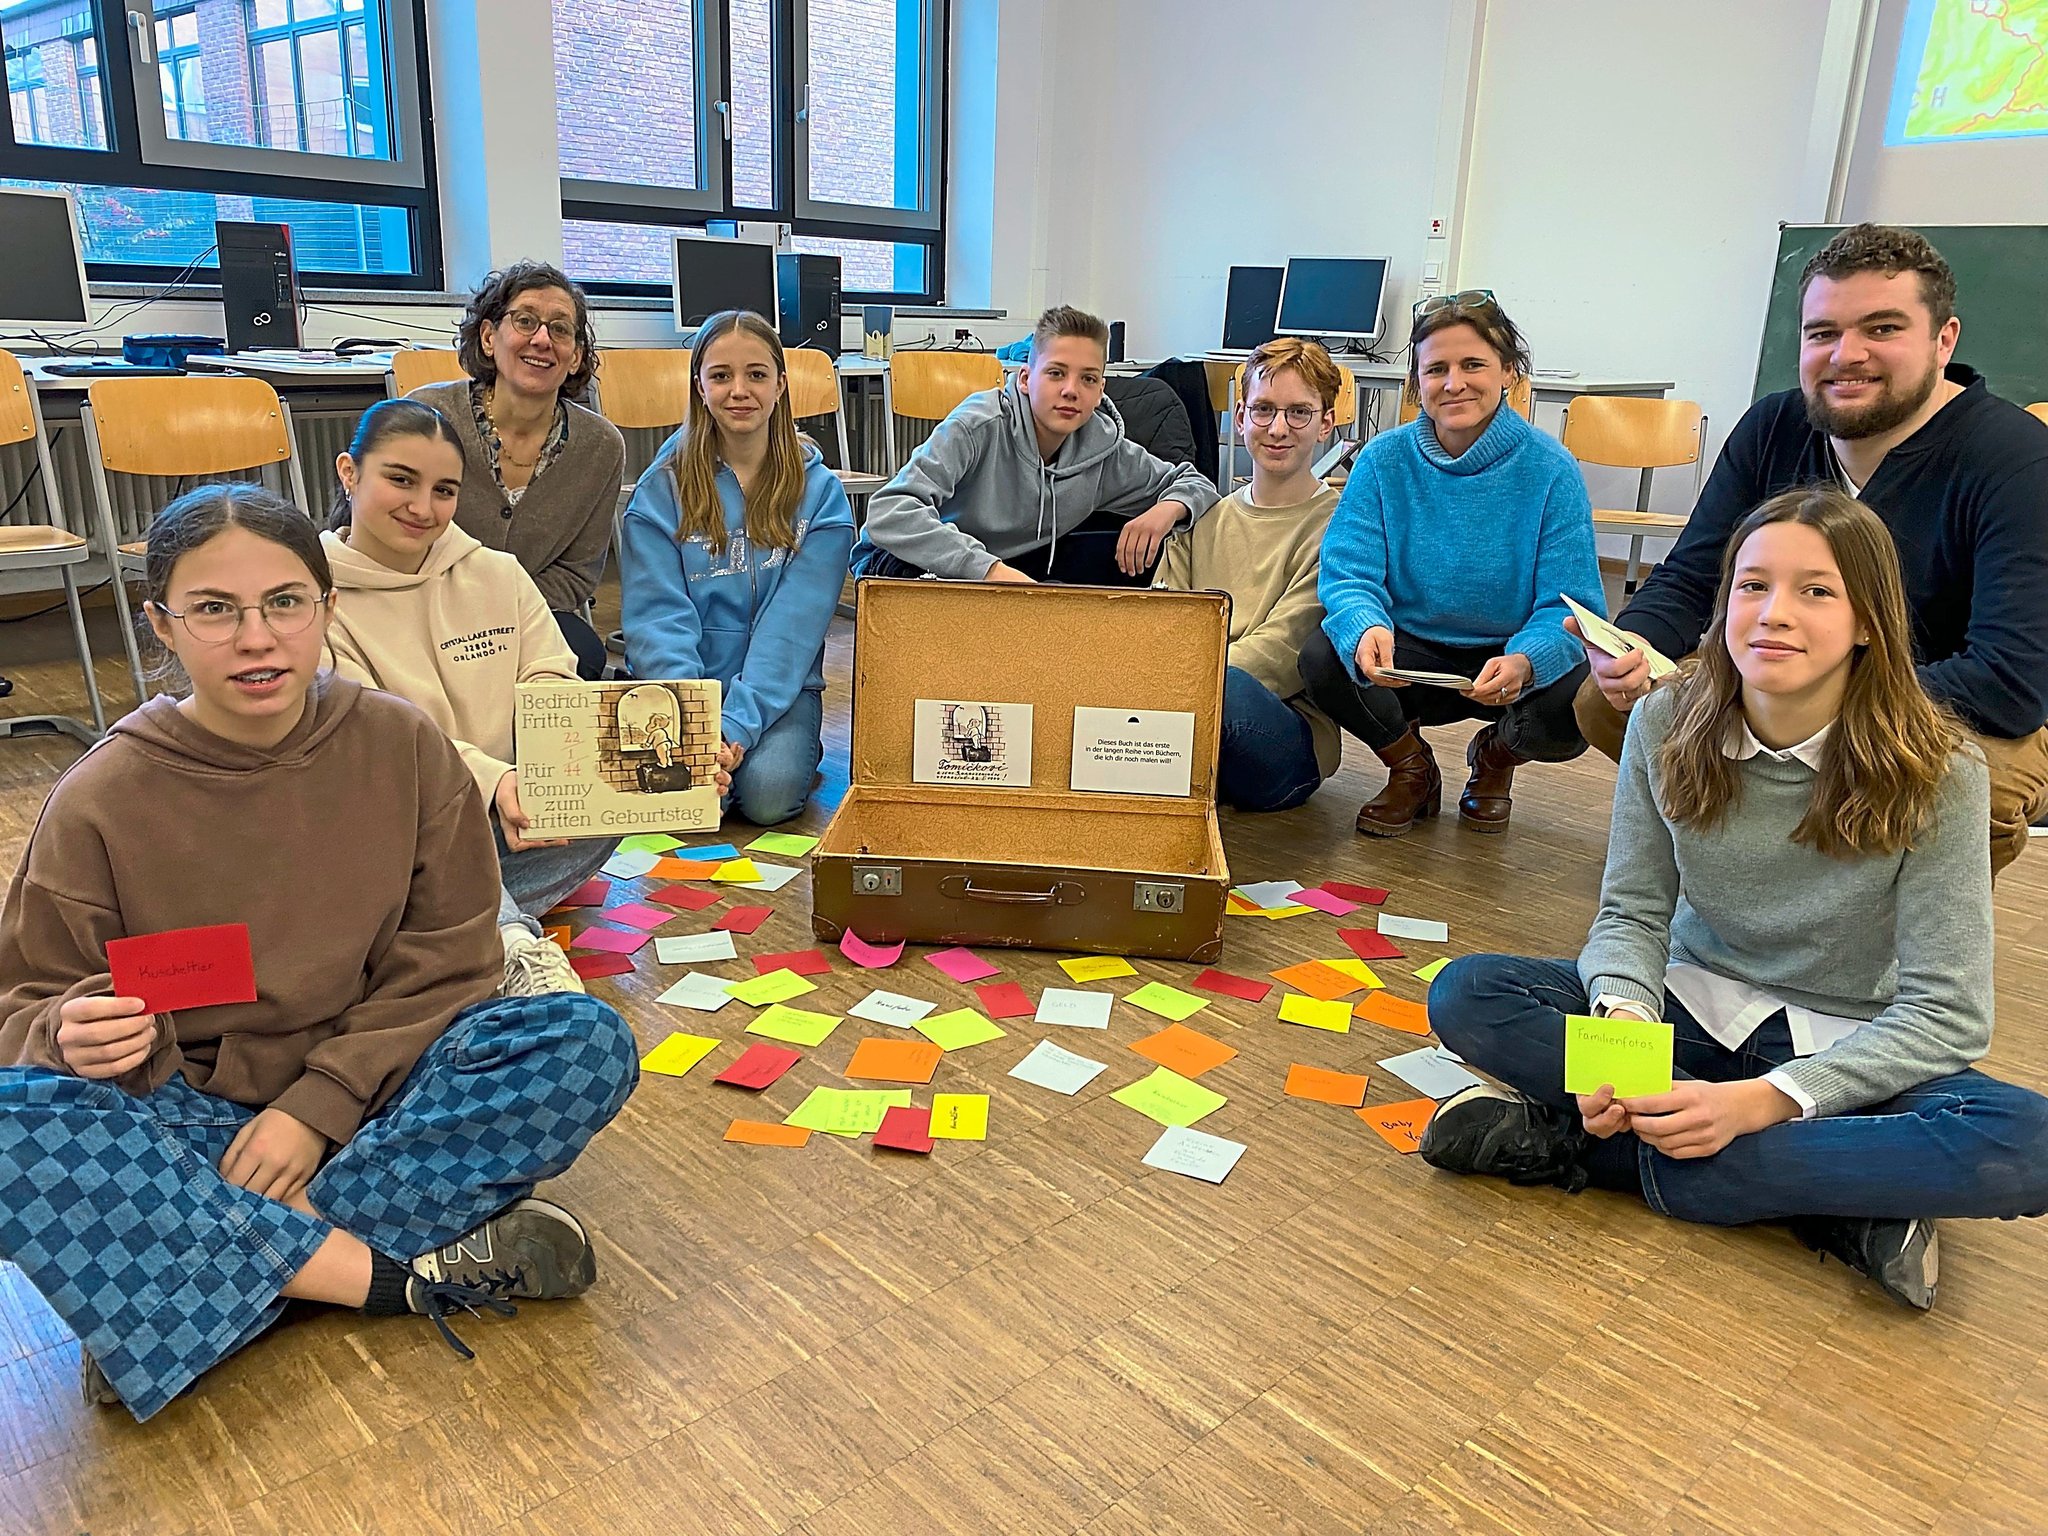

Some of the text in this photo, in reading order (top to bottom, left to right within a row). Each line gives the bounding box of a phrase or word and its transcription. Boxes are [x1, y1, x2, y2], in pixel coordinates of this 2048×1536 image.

[440, 626, 515, 650] CRYSTAL LAKE STREET
[453, 644, 508, 662] ORLANDO FL
[521, 693, 589, 710] Bedřich
[522, 713, 573, 729] Fritta
[1097, 738, 1117, 746] Dieses
[1103, 746, 1124, 755] langen
[1155, 749, 1182, 758] Büchern,
[524, 763, 555, 778] Für
[525, 782, 593, 798] Tommy
[545, 799, 585, 812] zum
[529, 808, 704, 829] dritten Geburtstag
[1577, 1027, 1654, 1050] Familienfotos
[1381, 1120, 1413, 1130] Baby
